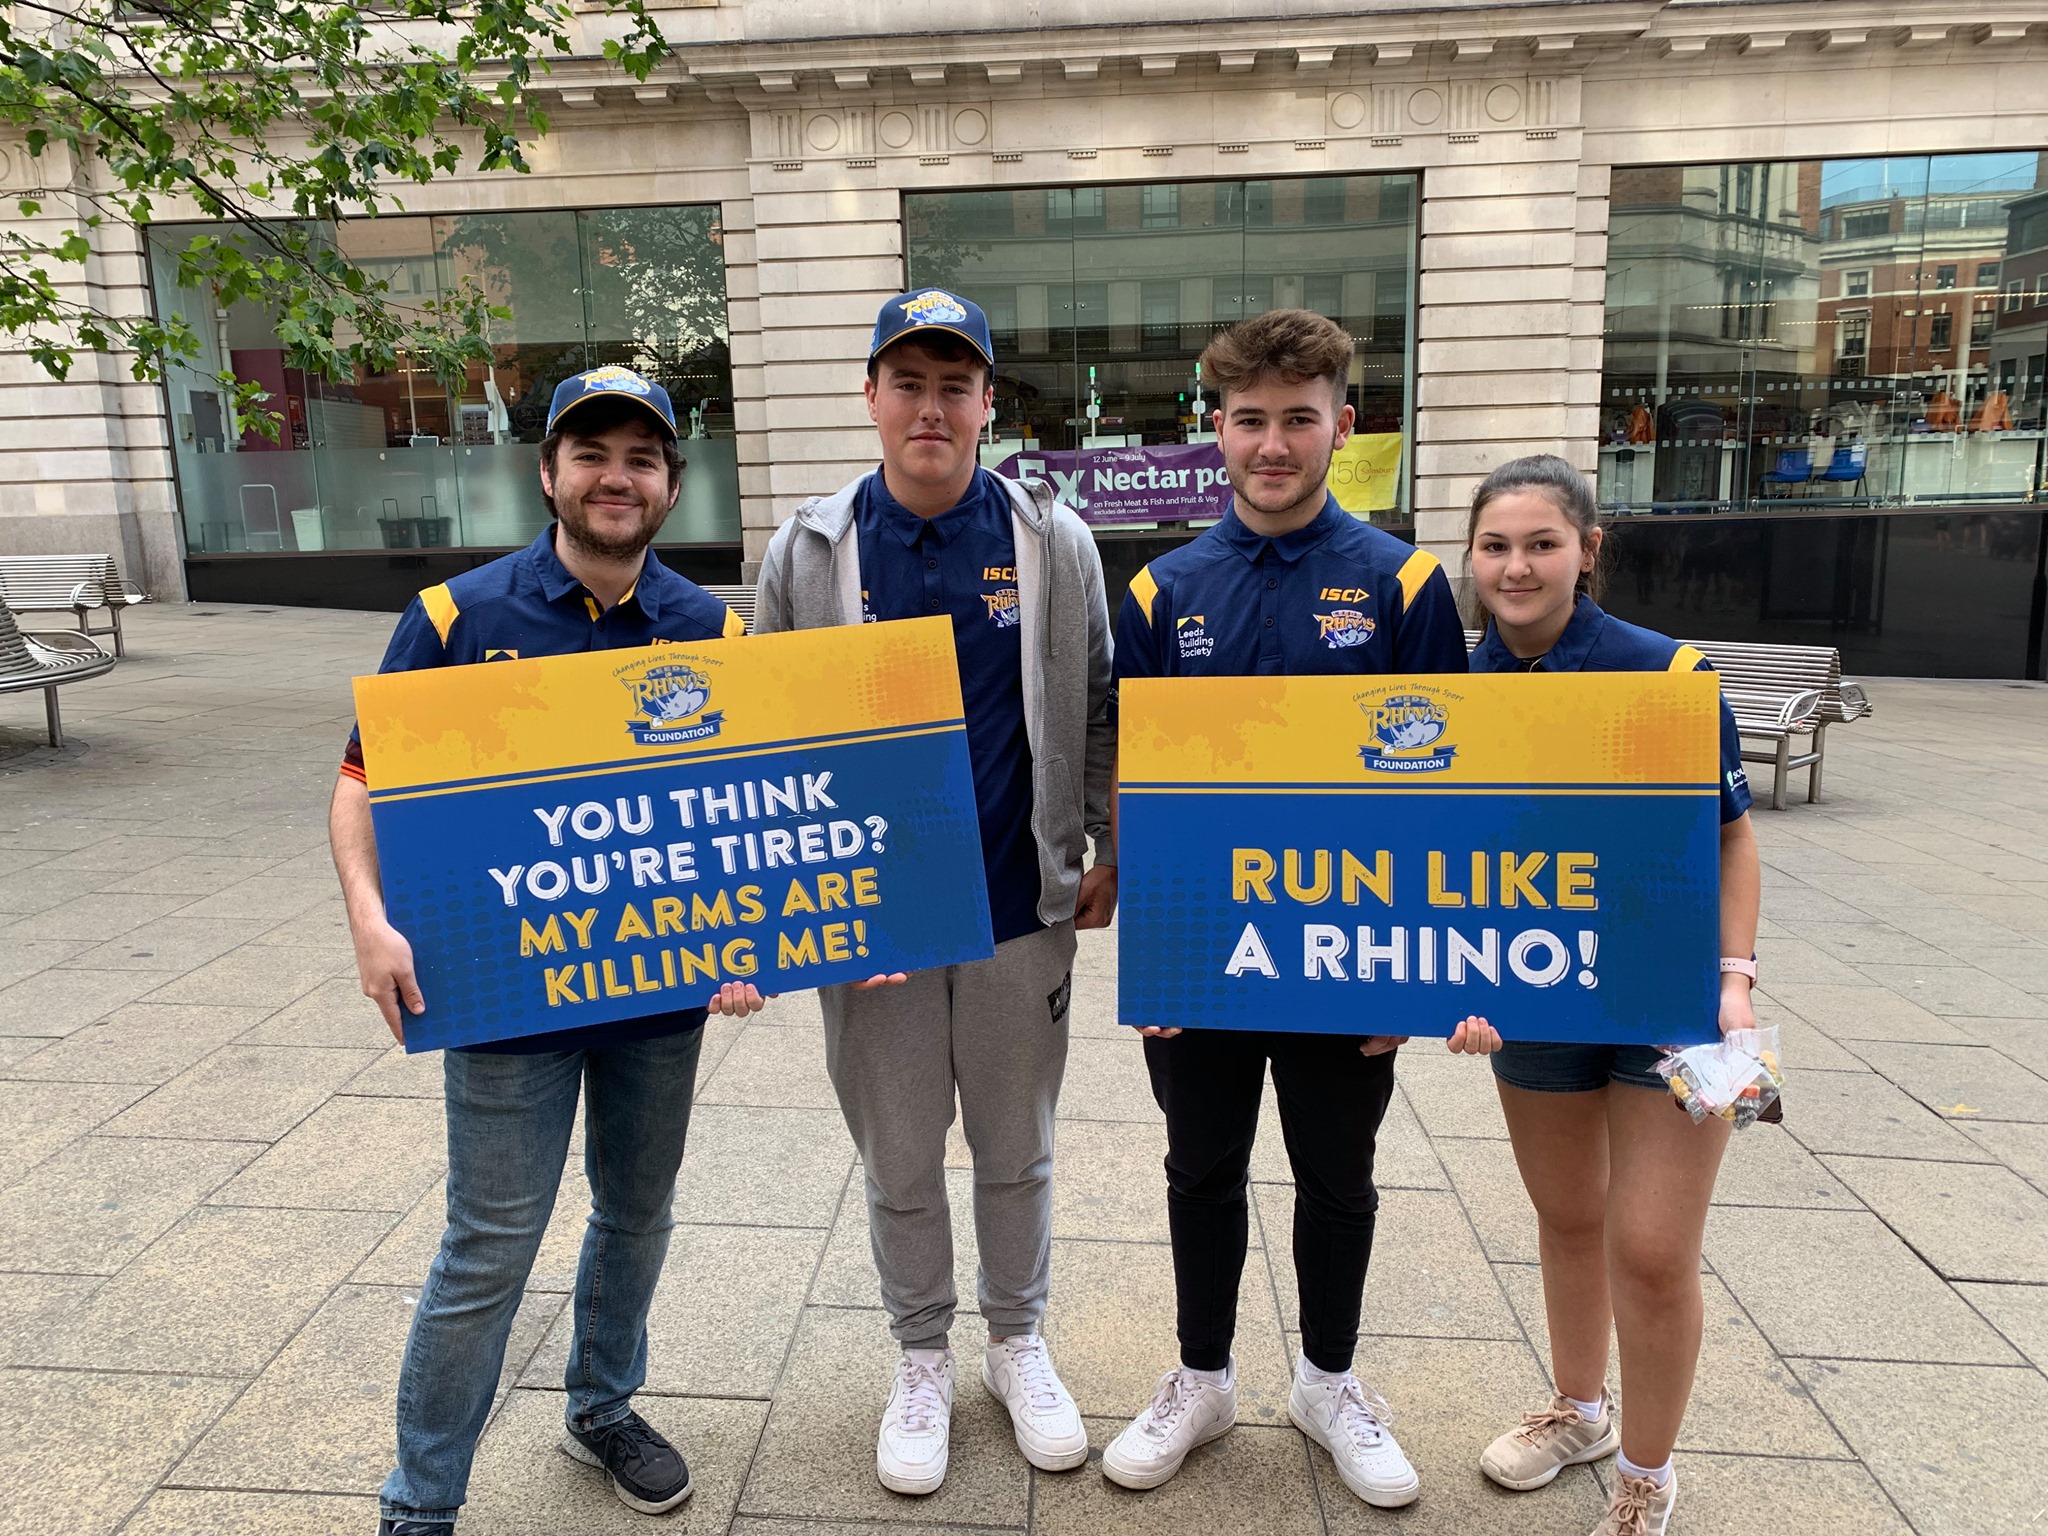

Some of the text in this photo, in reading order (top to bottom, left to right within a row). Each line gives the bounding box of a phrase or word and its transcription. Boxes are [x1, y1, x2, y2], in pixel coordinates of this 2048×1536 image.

[1101, 455, 1118, 463] June
[1131, 454, 1146, 463] July
[1093, 465, 1191, 493] Nectar
[1093, 495, 1219, 509] on Fresh Meat & Fish and Fruit & Veg
[1126, 507, 1149, 515] counters
[983, 567, 1013, 581] ISC
[1320, 588, 1356, 602] ISC
[1178, 627, 1205, 639] Leeds
[1179, 637, 1214, 649] Building
[1180, 646, 1212, 658] Society
[612, 652, 725, 678] Changing Lives Through Sport
[648, 666, 690, 676] LEEDS
[1352, 682, 1465, 702] Changing Lives Through Sport
[1387, 696, 1429, 706] LEEDS
[643, 725, 714, 742] FOUNDATION
[1373, 758, 1445, 771] FOUNDATION
[533, 771, 839, 847] YOU THINK
[488, 815, 888, 907] YOU'RE TIRED?
[1232, 847, 1599, 911] RUN LIKE
[519, 866, 881, 958] MY ARMS ARE
[1224, 922, 1599, 989] A RHINO!
[543, 919, 870, 1008] KILLING ME!
